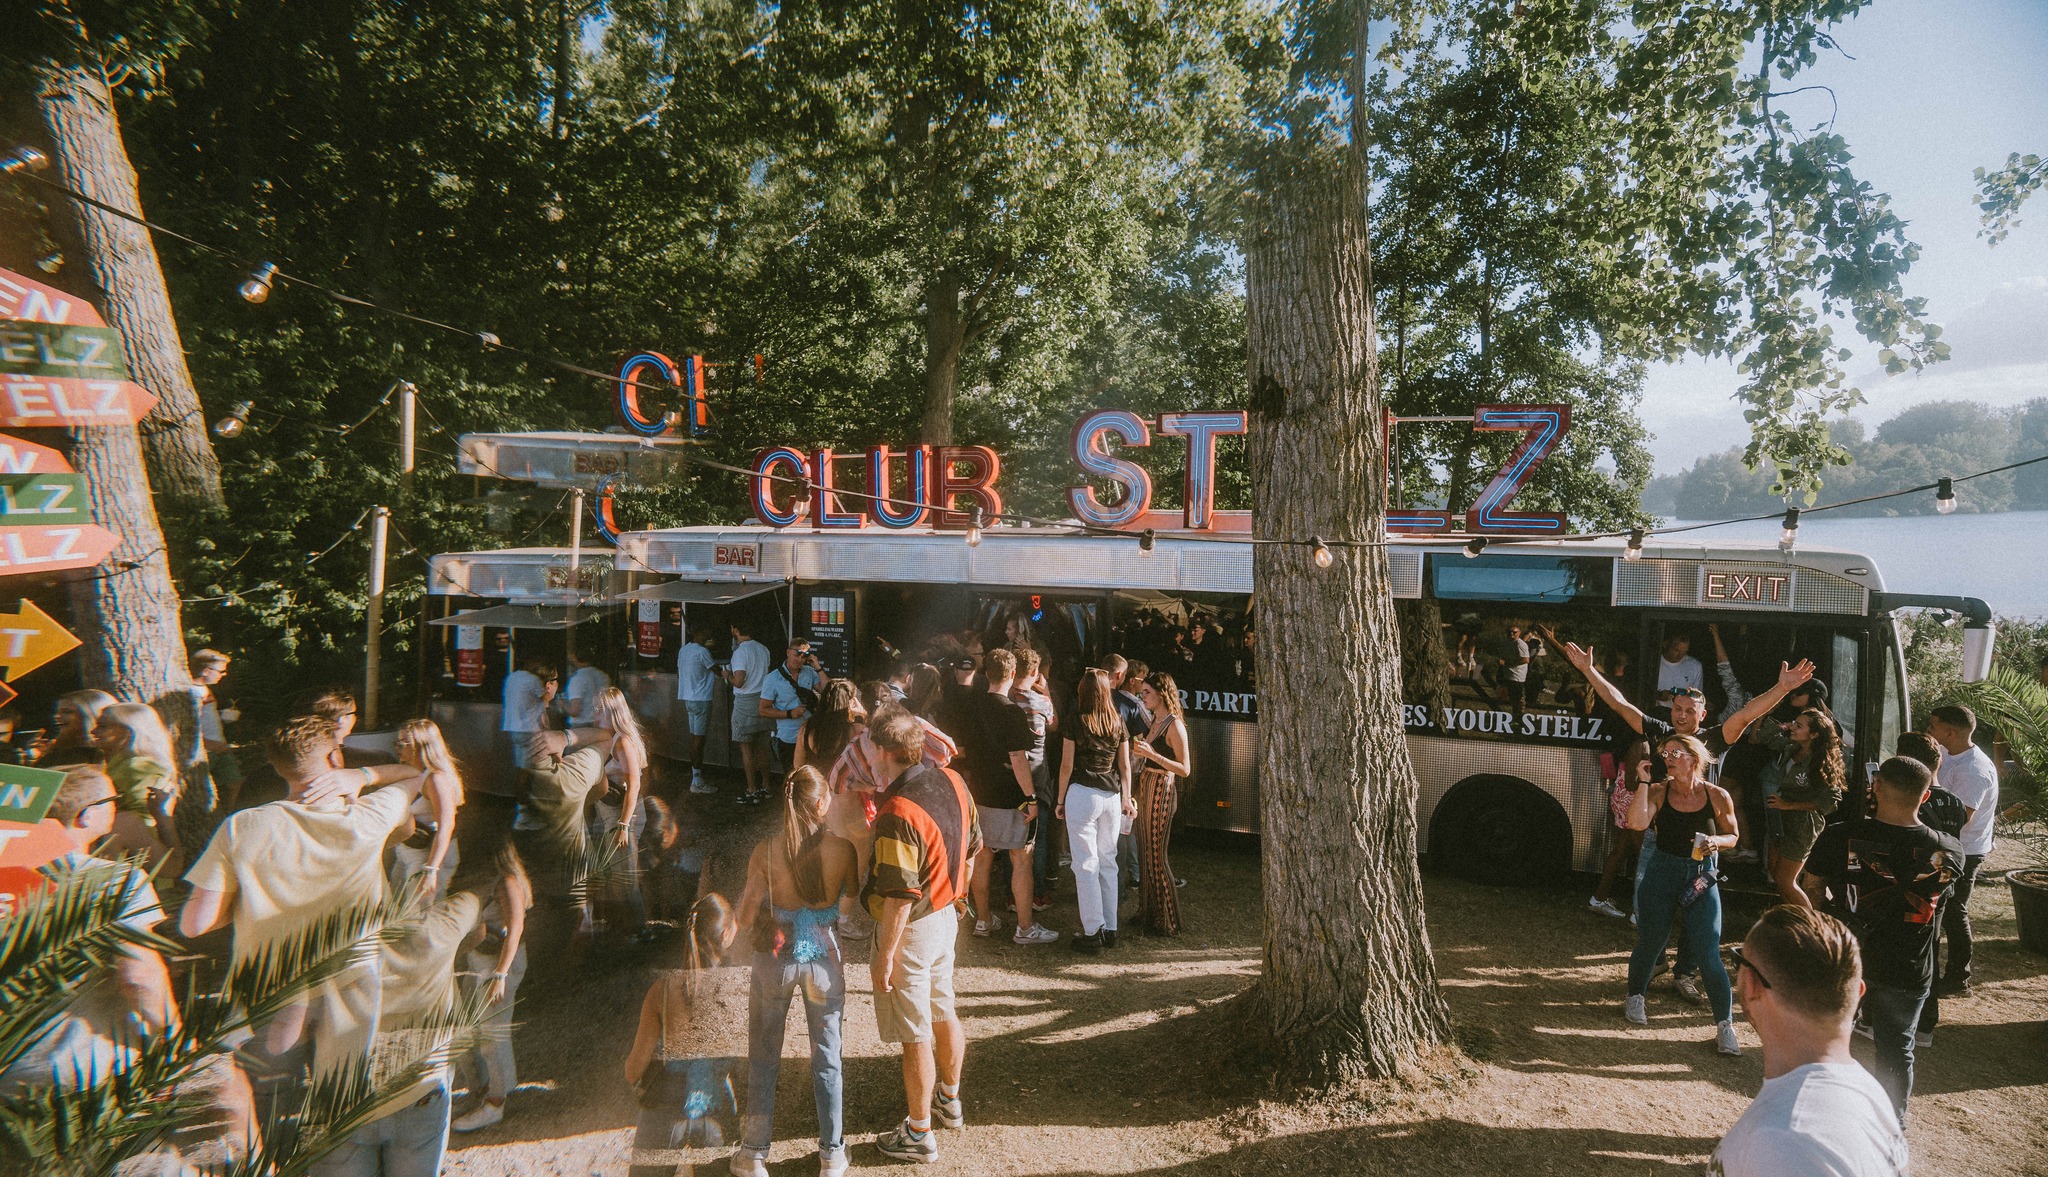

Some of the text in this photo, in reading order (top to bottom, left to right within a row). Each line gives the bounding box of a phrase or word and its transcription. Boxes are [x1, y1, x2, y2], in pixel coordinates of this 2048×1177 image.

[0, 374, 129, 417] ËLZ
[750, 445, 1002, 530] CLUB
[1065, 404, 1572, 535] STLZ
[0, 528, 88, 567] LZ
[716, 546, 754, 567] BAR
[1707, 574, 1787, 601] EXIT
[1444, 708, 1514, 733] YOUR
[1521, 709, 1612, 741] STËLZ.
[0, 782, 40, 809] N
